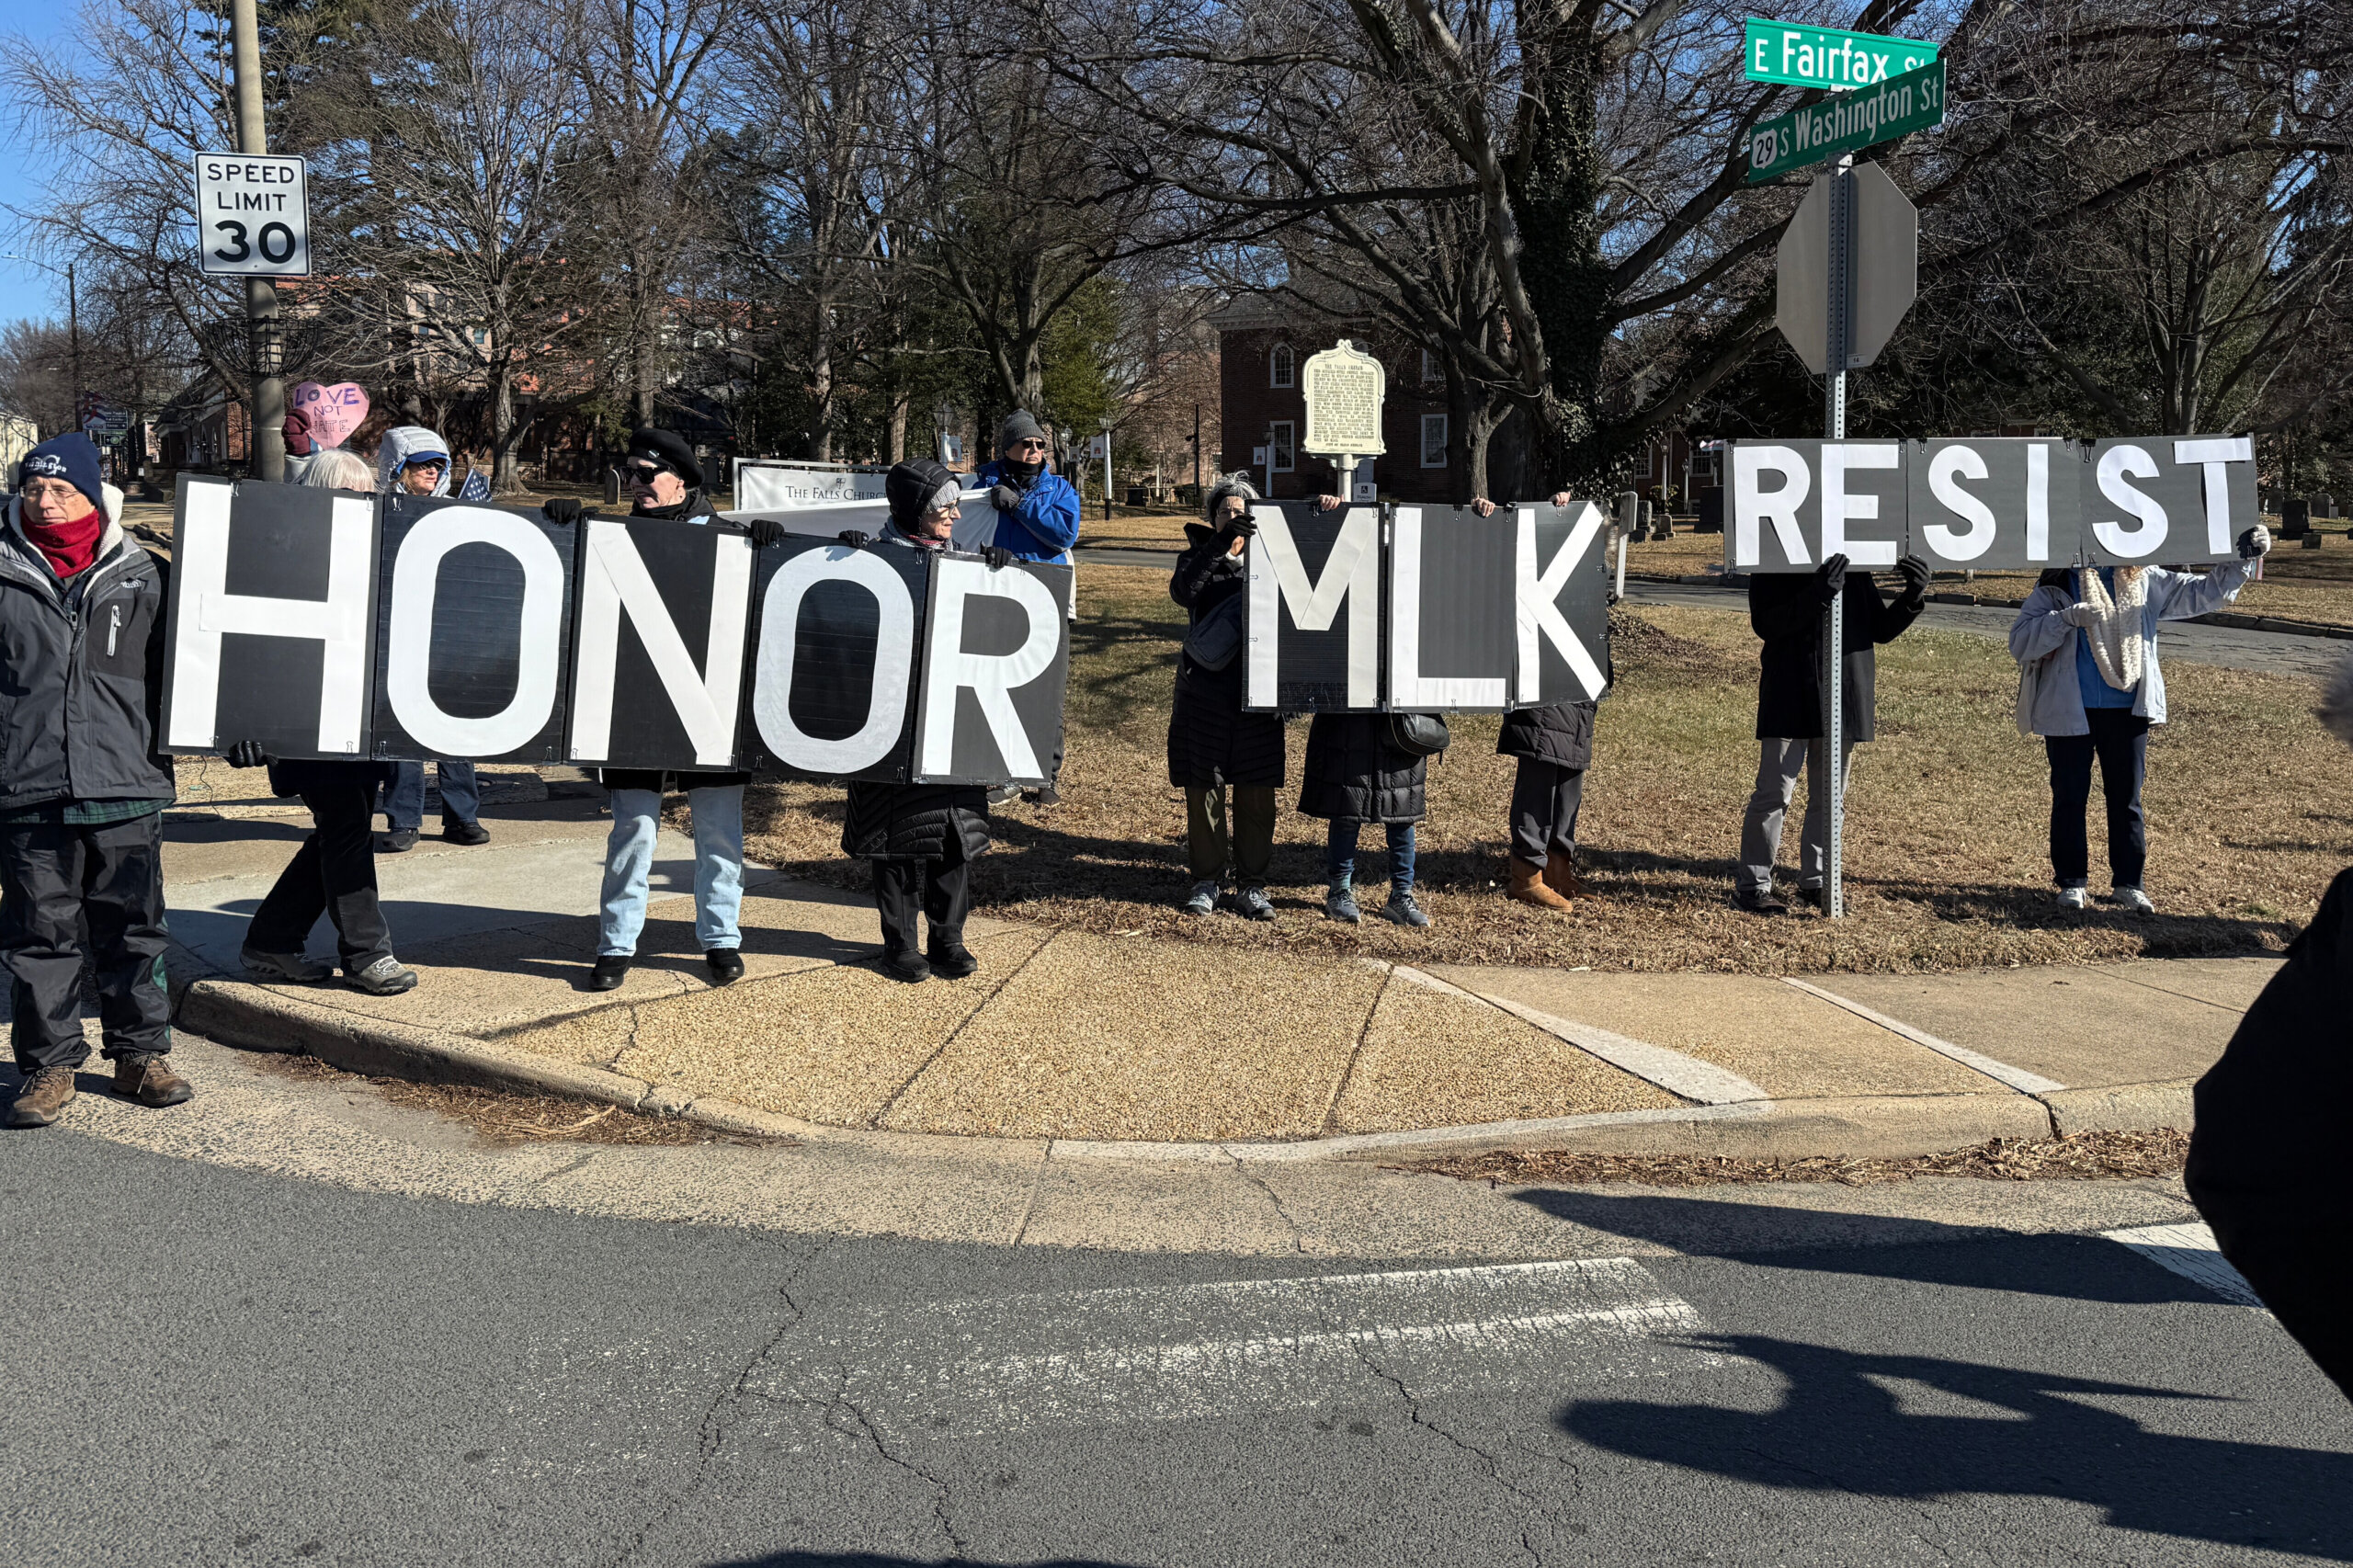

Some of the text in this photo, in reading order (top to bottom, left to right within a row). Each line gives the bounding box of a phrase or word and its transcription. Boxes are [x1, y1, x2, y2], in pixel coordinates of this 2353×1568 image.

[1755, 39, 1769, 73] E
[1782, 31, 1890, 84] Fairfax
[1756, 75, 1939, 166] 29 S Washington St
[207, 163, 295, 184] SPEED
[217, 191, 287, 211] LIMIT
[214, 220, 296, 264] 30
[295, 388, 360, 406] LOVE
[313, 405, 343, 416] NOT
[310, 419, 351, 434] HATE
[786, 485, 888, 501] THE FALLS CHURC
[1733, 437, 2253, 566] RESIST
[169, 480, 1608, 781] HONOR MLK
